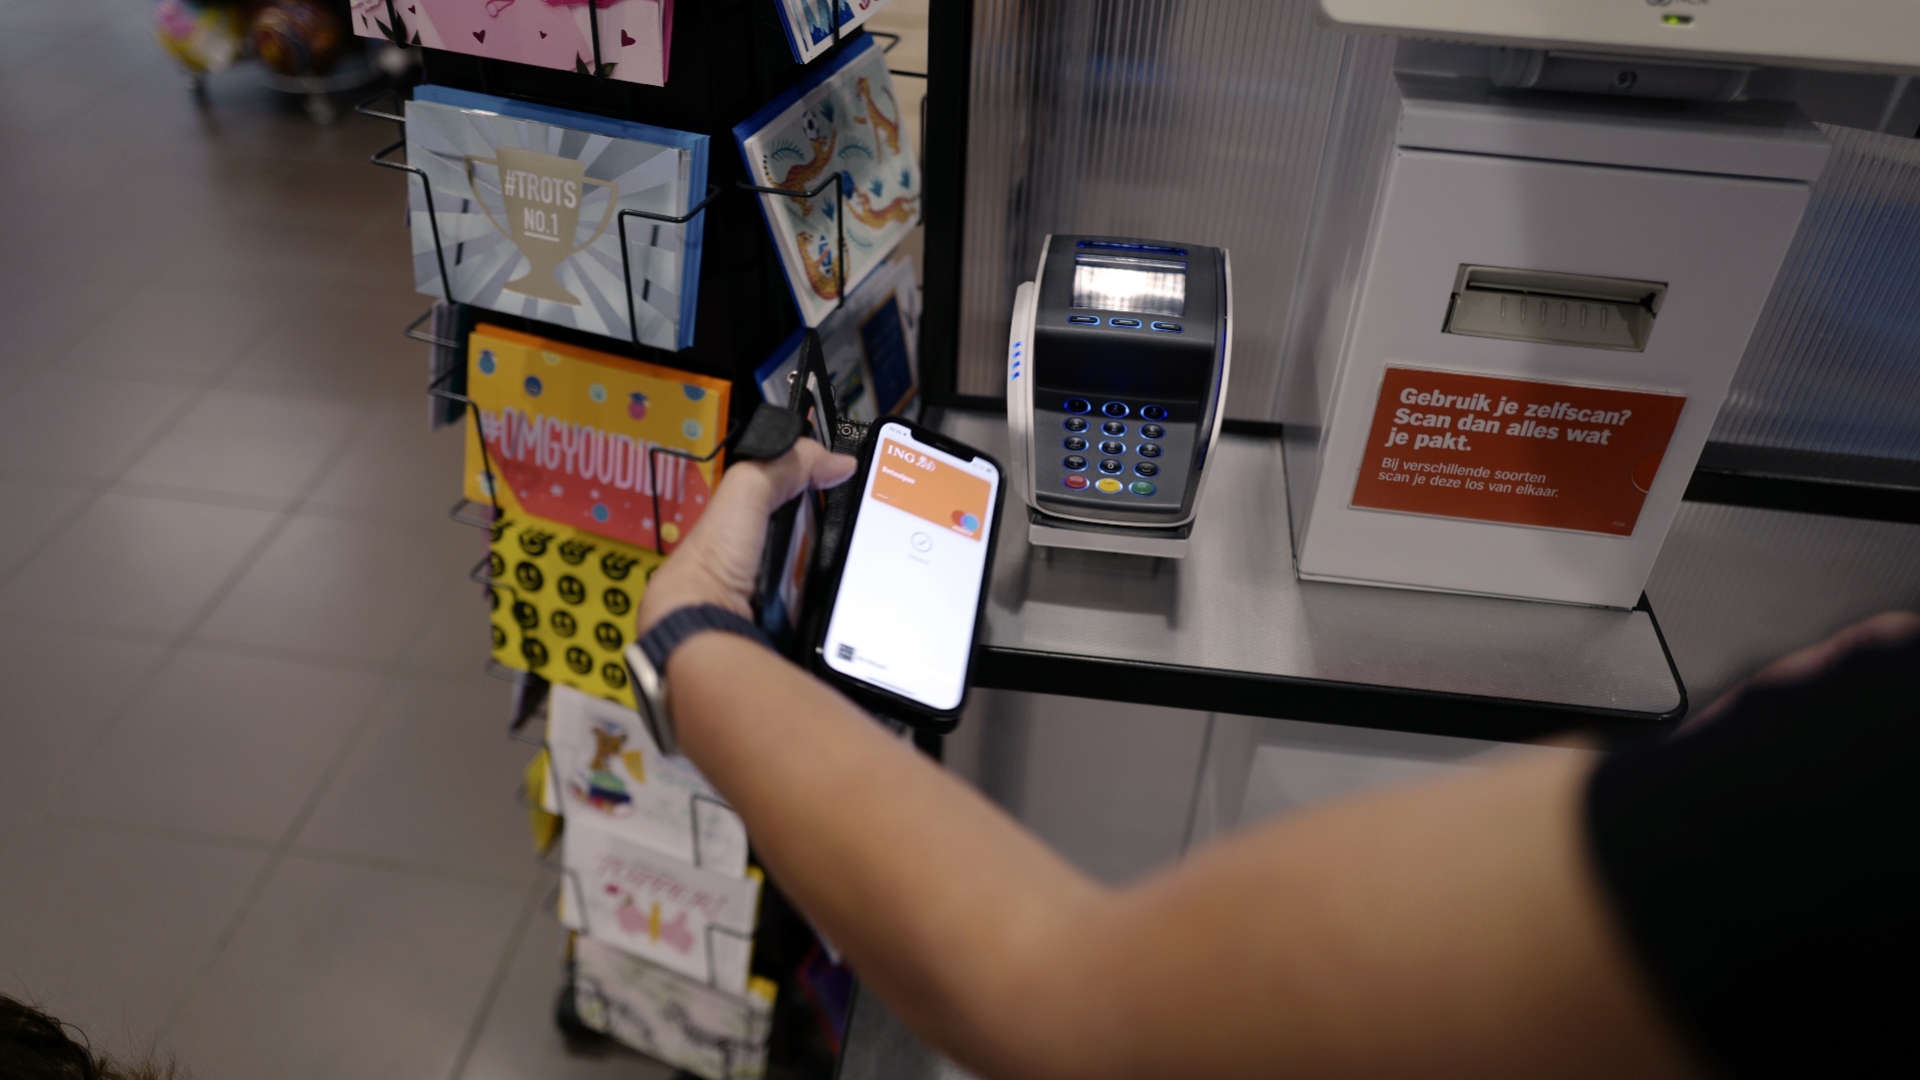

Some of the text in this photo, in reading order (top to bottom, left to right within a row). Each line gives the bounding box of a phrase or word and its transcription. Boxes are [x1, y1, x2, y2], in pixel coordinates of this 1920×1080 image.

[504, 168, 577, 209] #TROTS
[523, 207, 559, 236] NO.1
[1399, 387, 1632, 426] Gebruik je zelfscan?
[1384, 427, 1472, 451] je pakt.
[1393, 407, 1612, 445] Scan dan alles wat
[477, 406, 688, 504] #OMGYOUDIDIT
[887, 444, 916, 464] ING
[1378, 471, 1560, 498] scan je deze los van elkaar.
[1381, 457, 1547, 484] Bij verschillende soorten
